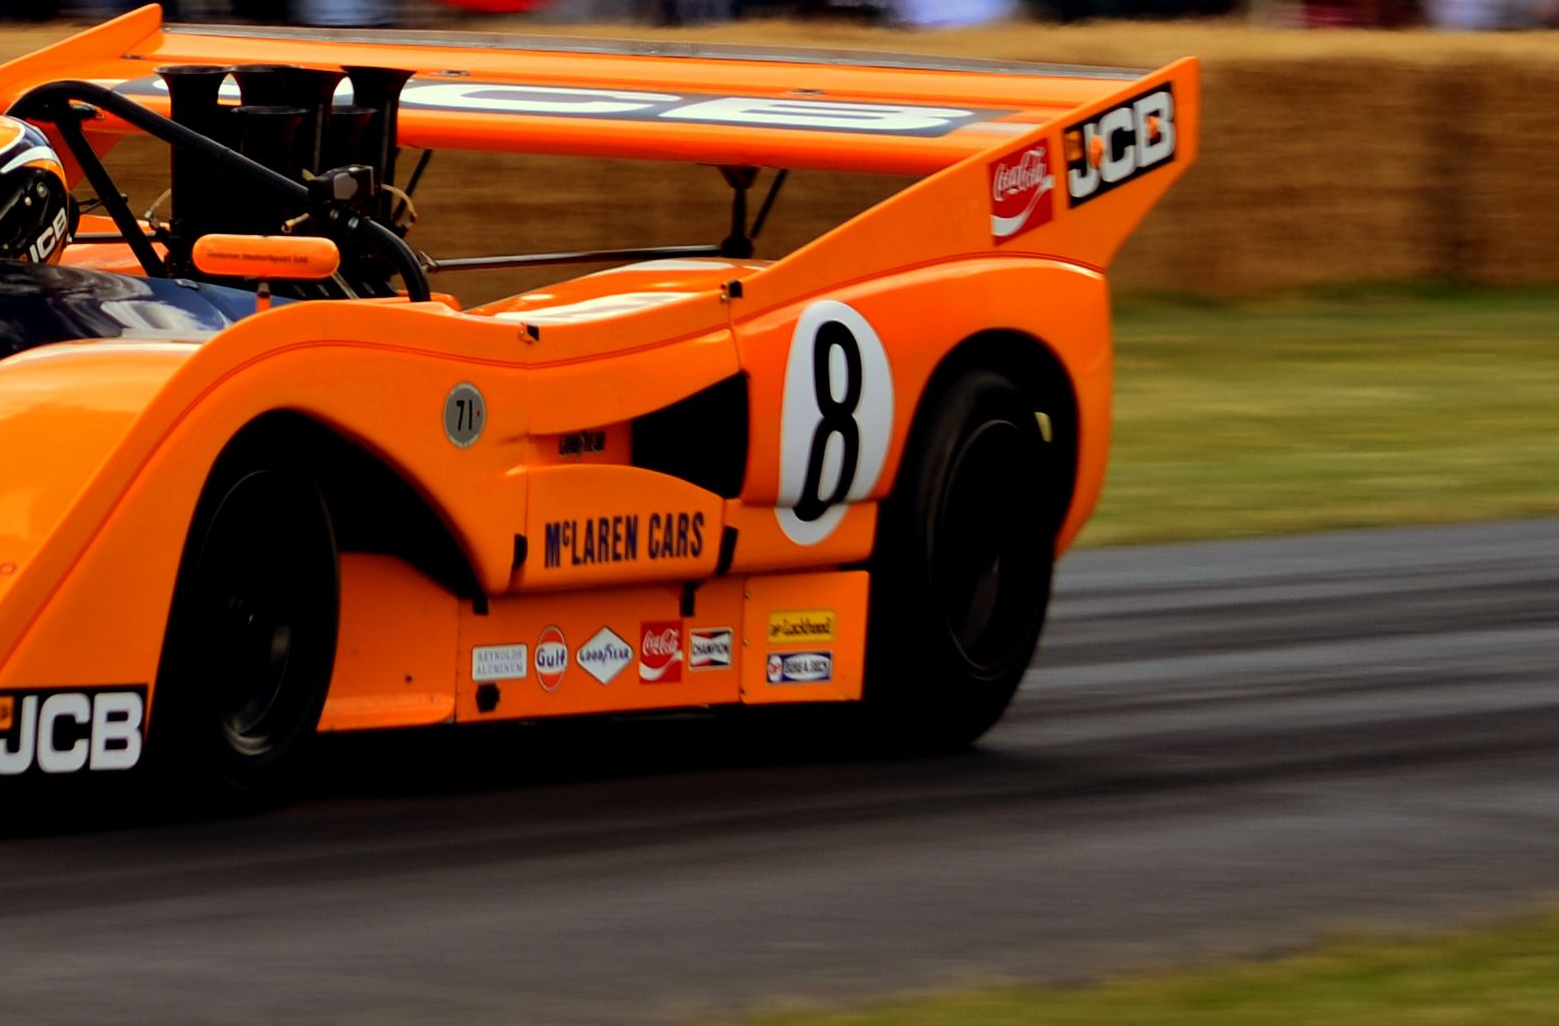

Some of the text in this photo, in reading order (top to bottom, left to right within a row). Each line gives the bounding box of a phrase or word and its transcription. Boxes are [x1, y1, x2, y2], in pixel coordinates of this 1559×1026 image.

[1067, 91, 1176, 198] JCB
[456, 398, 473, 431] 71
[792, 320, 862, 522] 8
[648, 511, 705, 560] CARS
[536, 647, 566, 668] Gulf
